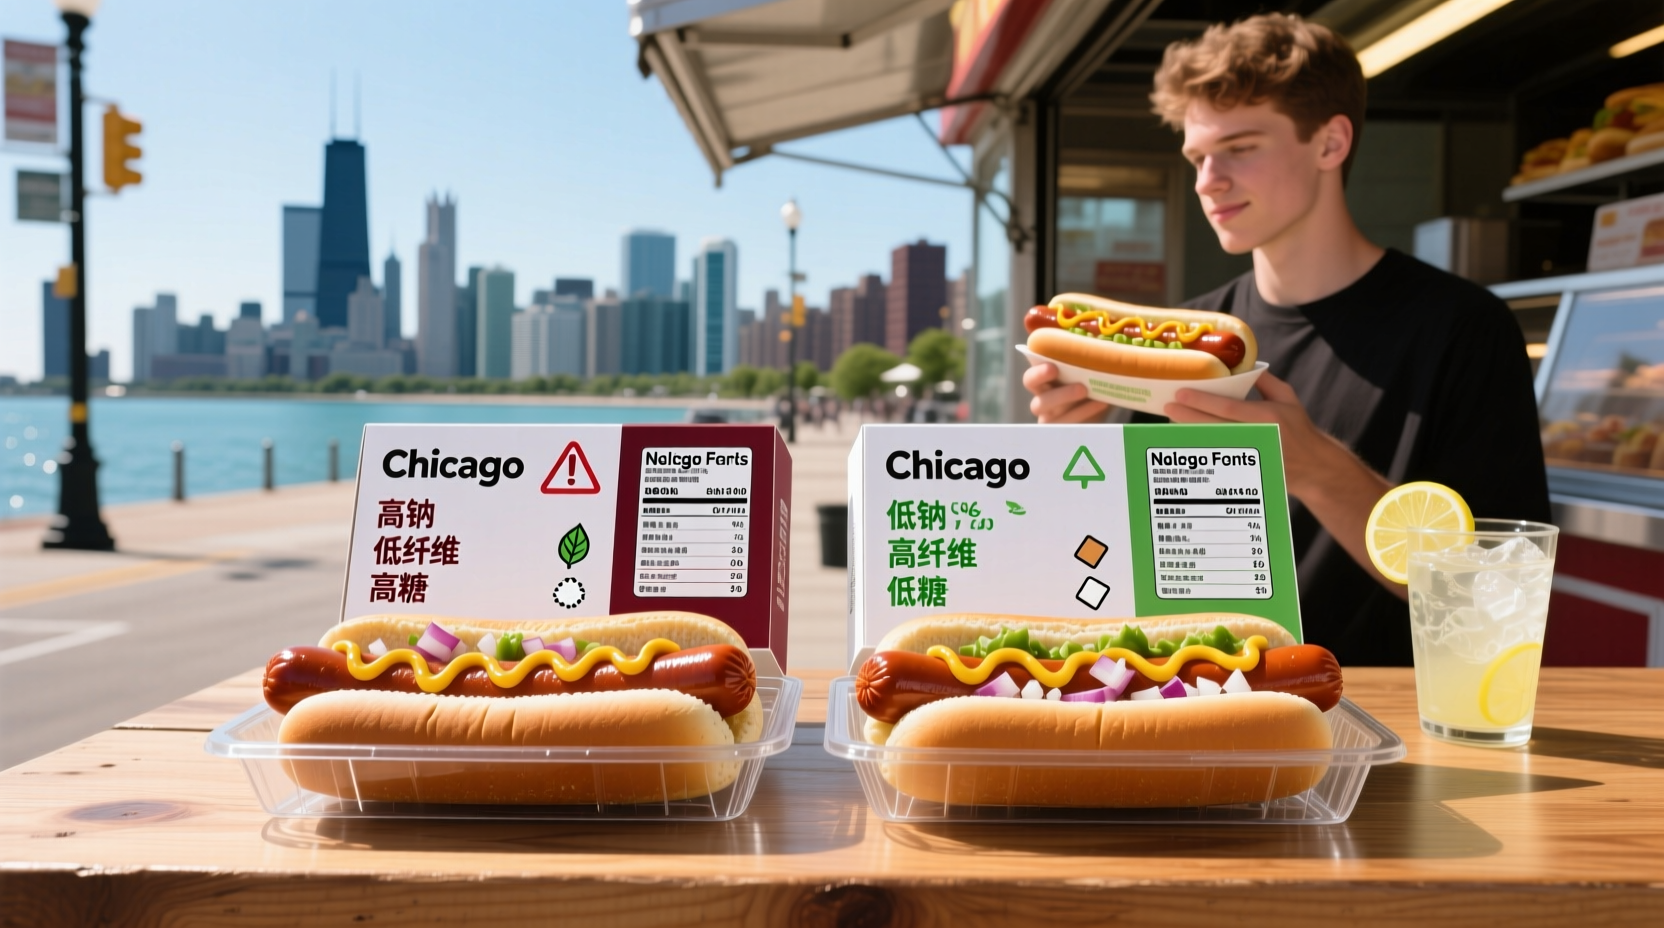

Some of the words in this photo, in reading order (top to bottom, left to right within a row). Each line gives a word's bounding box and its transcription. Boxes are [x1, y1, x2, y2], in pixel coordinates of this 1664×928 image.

[382, 448, 525, 488] Chicago
[885, 448, 1031, 489] Chicago
[377, 498, 436, 530] 高钠
[886, 499, 947, 531] 低钠
[373, 535, 461, 566] 低纤维
[887, 537, 978, 568] 高纤维
[369, 572, 429, 603] 高糖
[886, 575, 949, 607] 低糖
